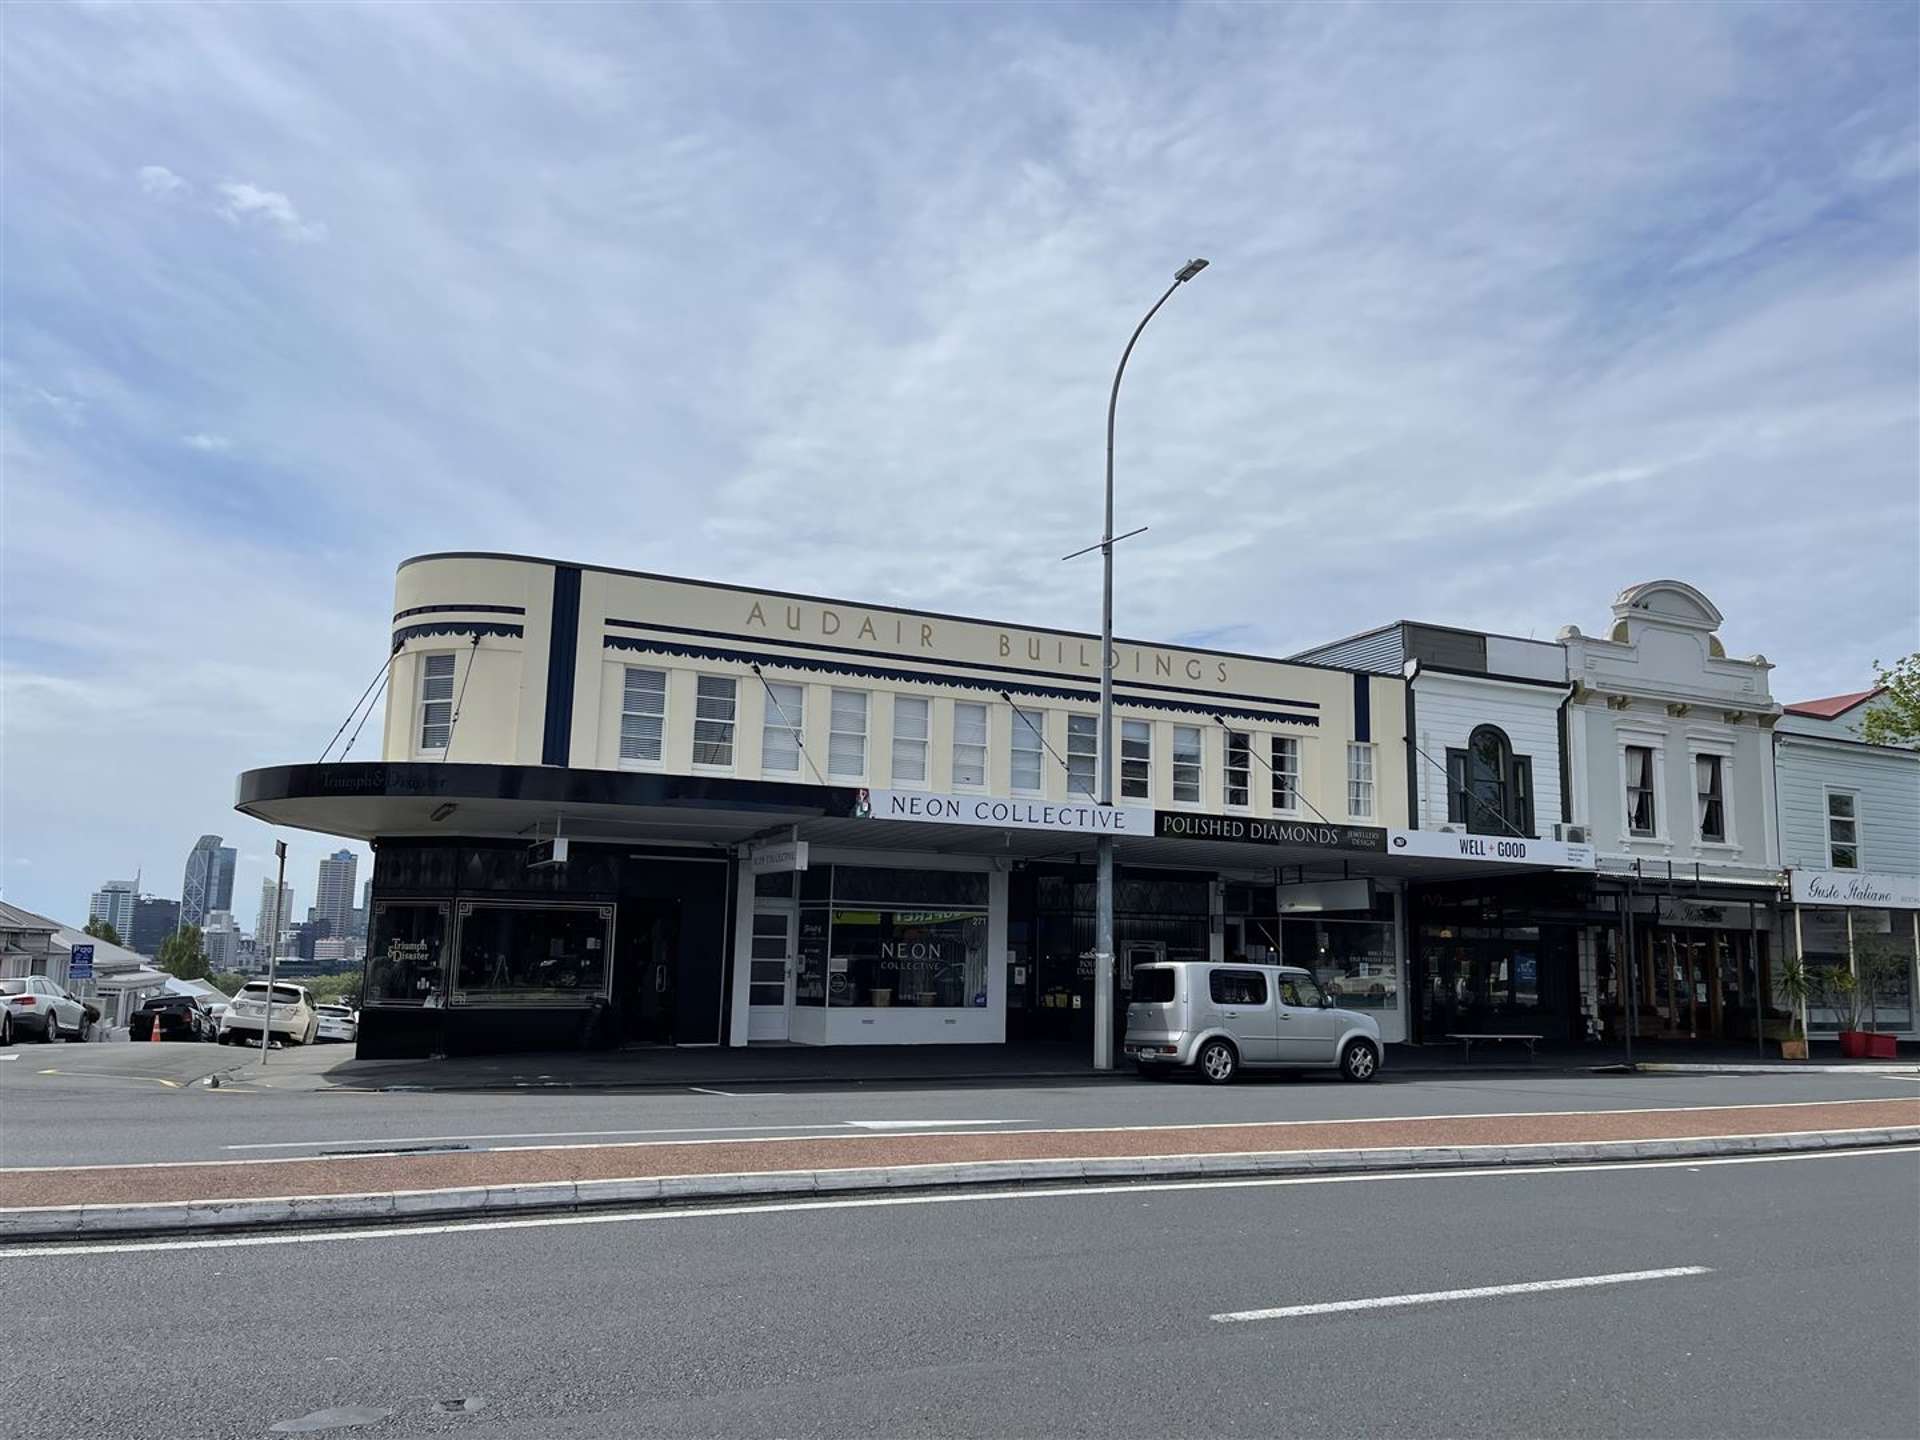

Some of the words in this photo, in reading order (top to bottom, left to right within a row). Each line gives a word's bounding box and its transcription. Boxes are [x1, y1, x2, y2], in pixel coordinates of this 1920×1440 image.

[746, 602, 933, 648] AUDAIR
[999, 634, 1226, 683] BUILDINGS
[892, 796, 960, 817] NEON
[975, 802, 1125, 829] COLLECTIVE
[1163, 816, 1244, 837] POLISHED
[1250, 823, 1338, 845] DIAMONDS
[1459, 839, 1486, 856] WELL
[1498, 842, 1526, 858] GOOD
[1808, 877, 1839, 898] Gusto
[1843, 877, 1892, 902] Italiano
[392, 938, 428, 952] Triumph
[881, 942, 941, 959] NEON
[881, 961, 940, 970] COLLECTIVE
